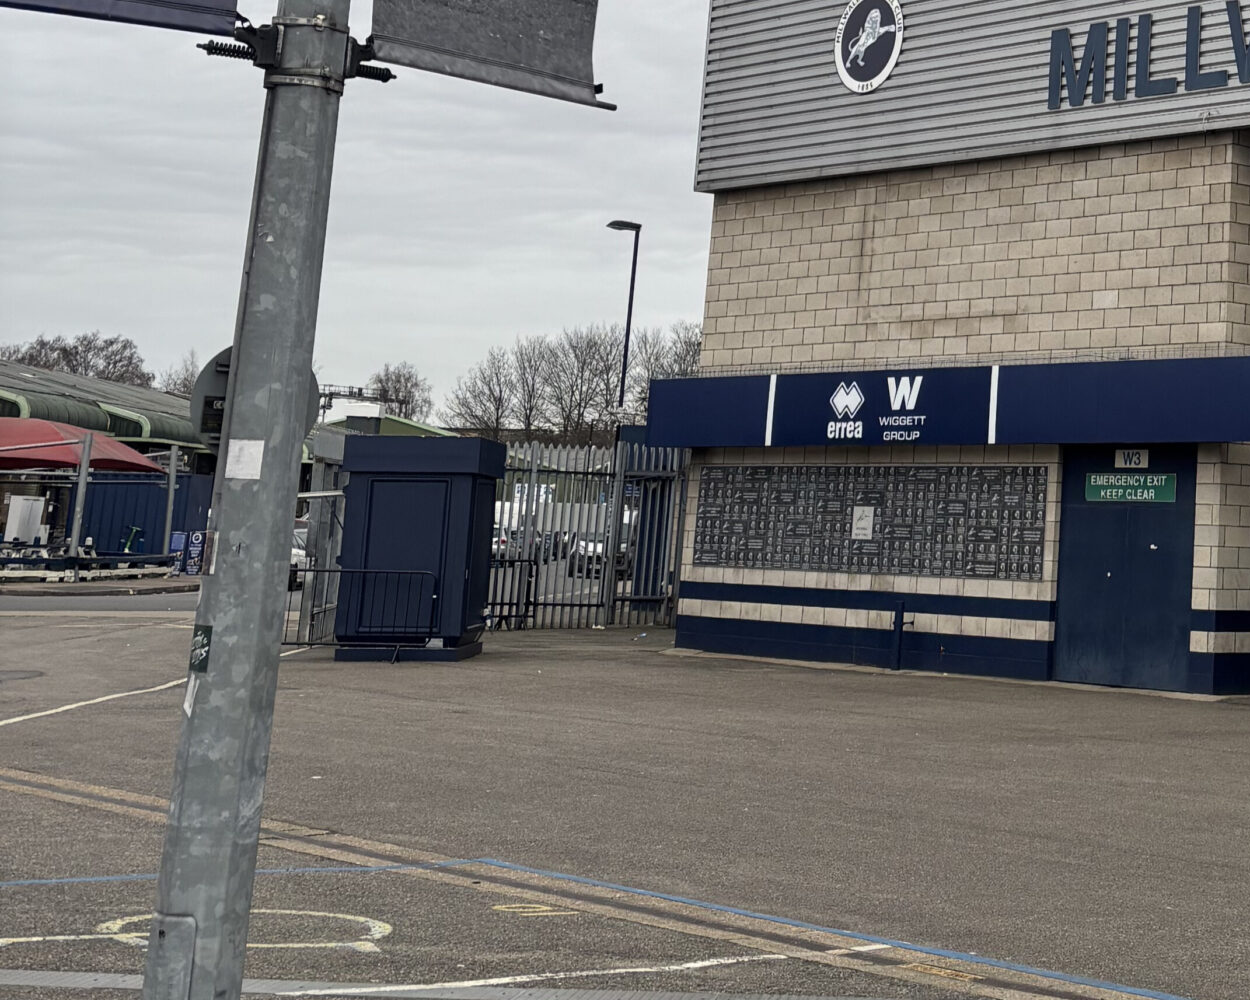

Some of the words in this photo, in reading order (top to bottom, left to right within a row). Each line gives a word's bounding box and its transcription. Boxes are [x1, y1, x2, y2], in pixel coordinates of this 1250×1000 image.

[894, 5, 903, 33] CLUB
[879, 415, 927, 426] WIGGETT
[826, 421, 863, 440] errea
[882, 431, 921, 441] GROUP
[1122, 451, 1142, 467] W3
[1090, 475, 1146, 486] EMERGENCY
[1147, 476, 1167, 486] EXIT
[1100, 489, 1124, 499] KEEP
[1125, 489, 1155, 500] CLEAR
